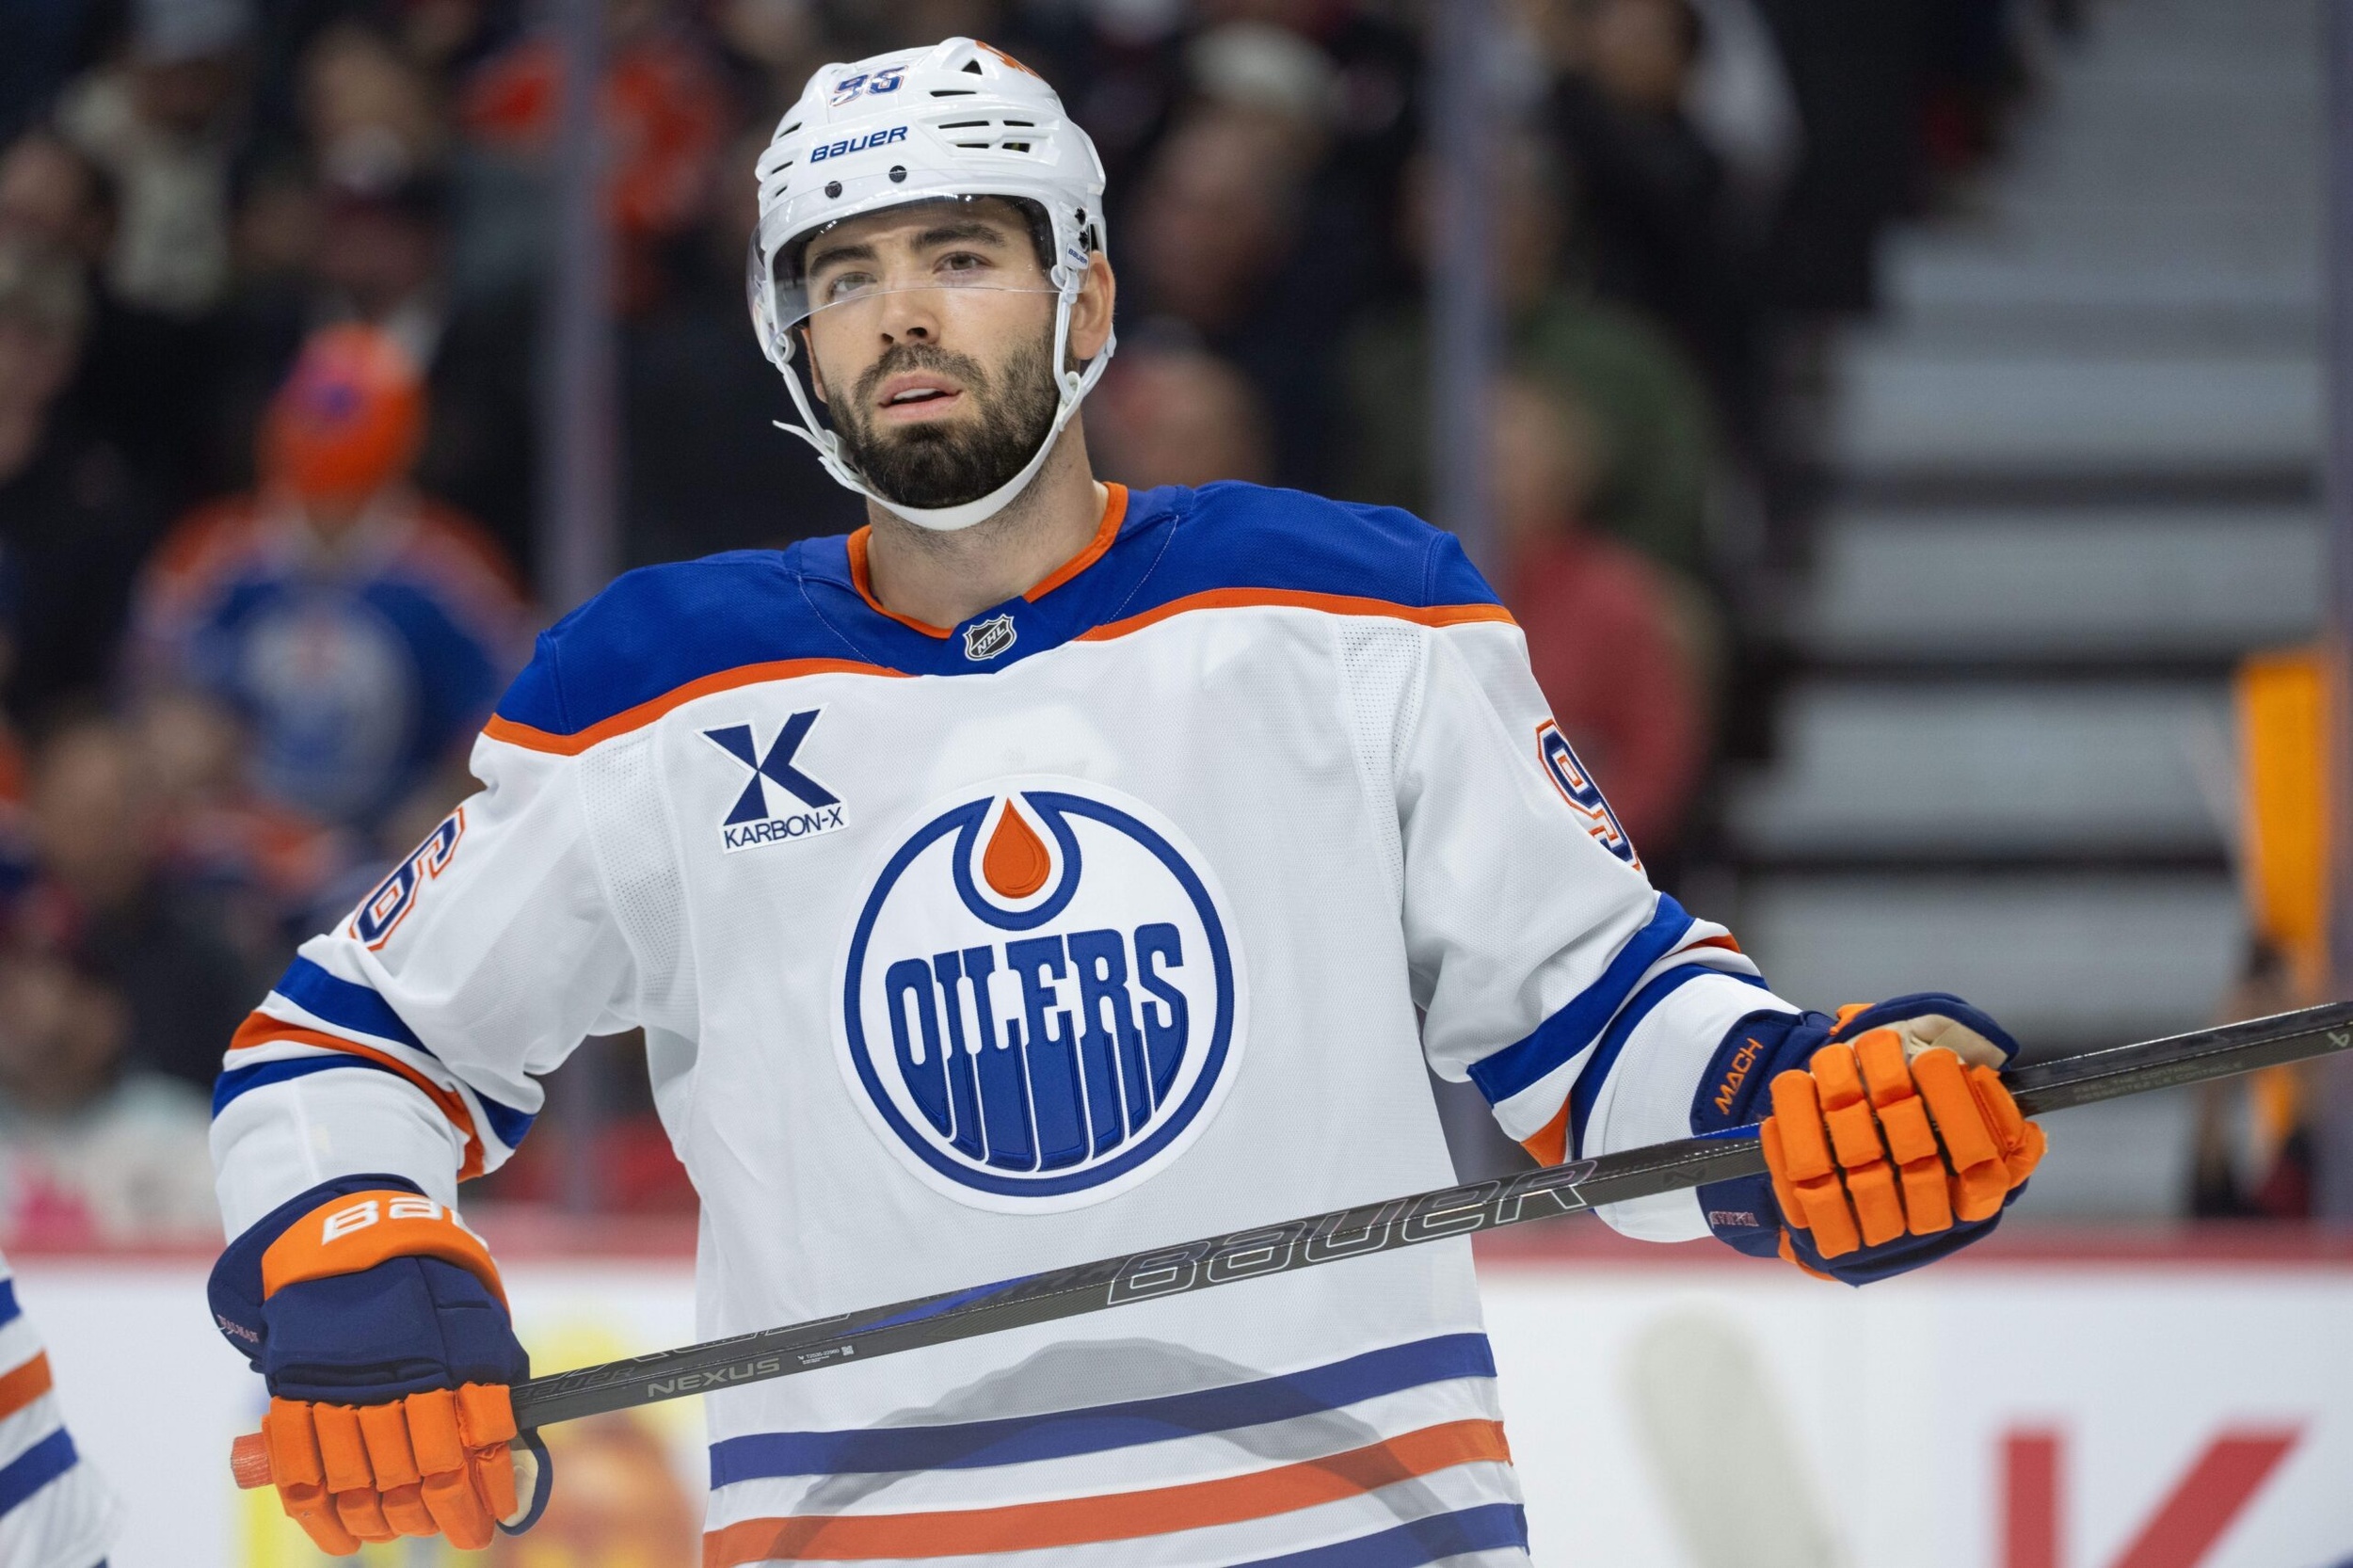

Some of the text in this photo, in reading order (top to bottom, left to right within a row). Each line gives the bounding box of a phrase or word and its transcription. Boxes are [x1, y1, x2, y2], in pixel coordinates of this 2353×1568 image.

[829, 64, 909, 107] 96
[810, 125, 908, 164] BAUER
[977, 625, 1005, 655] NHL
[724, 807, 844, 849] KARBON-X
[885, 921, 1190, 1173] OILERS
[1714, 1037, 1764, 1116] MACH
[1107, 1159, 1598, 1306] BAUER
[648, 1357, 780, 1398] NEXUS
